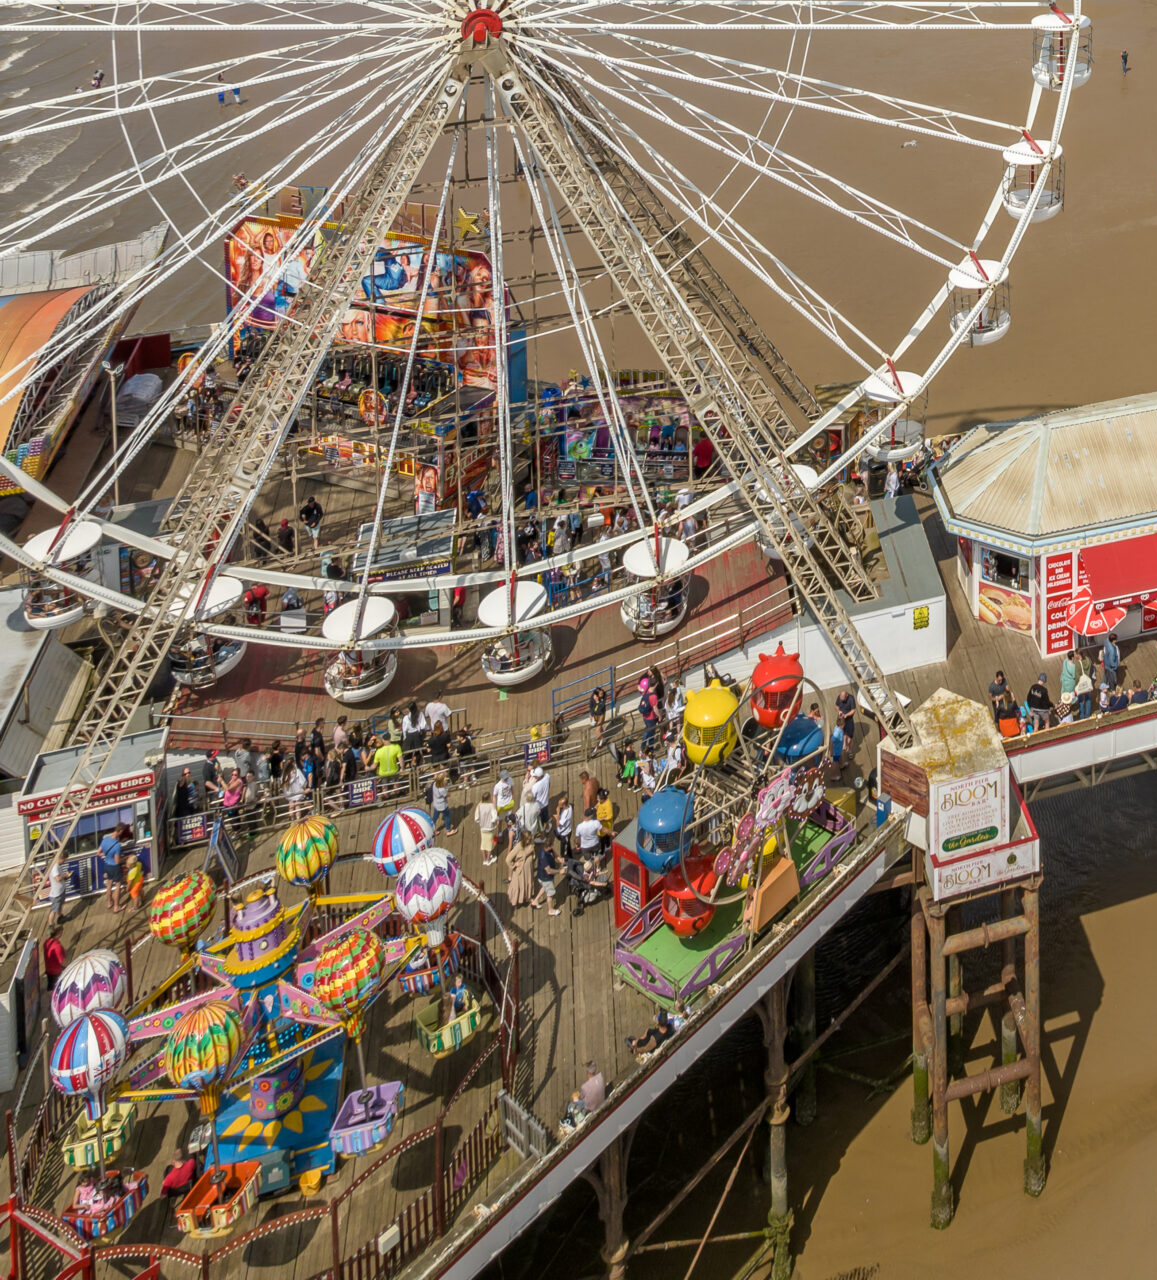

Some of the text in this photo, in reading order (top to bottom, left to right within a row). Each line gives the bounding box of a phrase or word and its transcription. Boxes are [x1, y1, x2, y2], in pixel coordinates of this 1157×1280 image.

[1050, 630, 1069, 640] SOLD
[1052, 640, 1069, 649] HERE
[950, 777, 988, 792] NORTH PIER
[20, 802, 34, 811] NO
[104, 783, 118, 792] ON
[120, 776, 152, 788] RIDES
[940, 780, 998, 812] BLOOM
[972, 799, 986, 807] BAR
[944, 863, 991, 890] BLOOM
